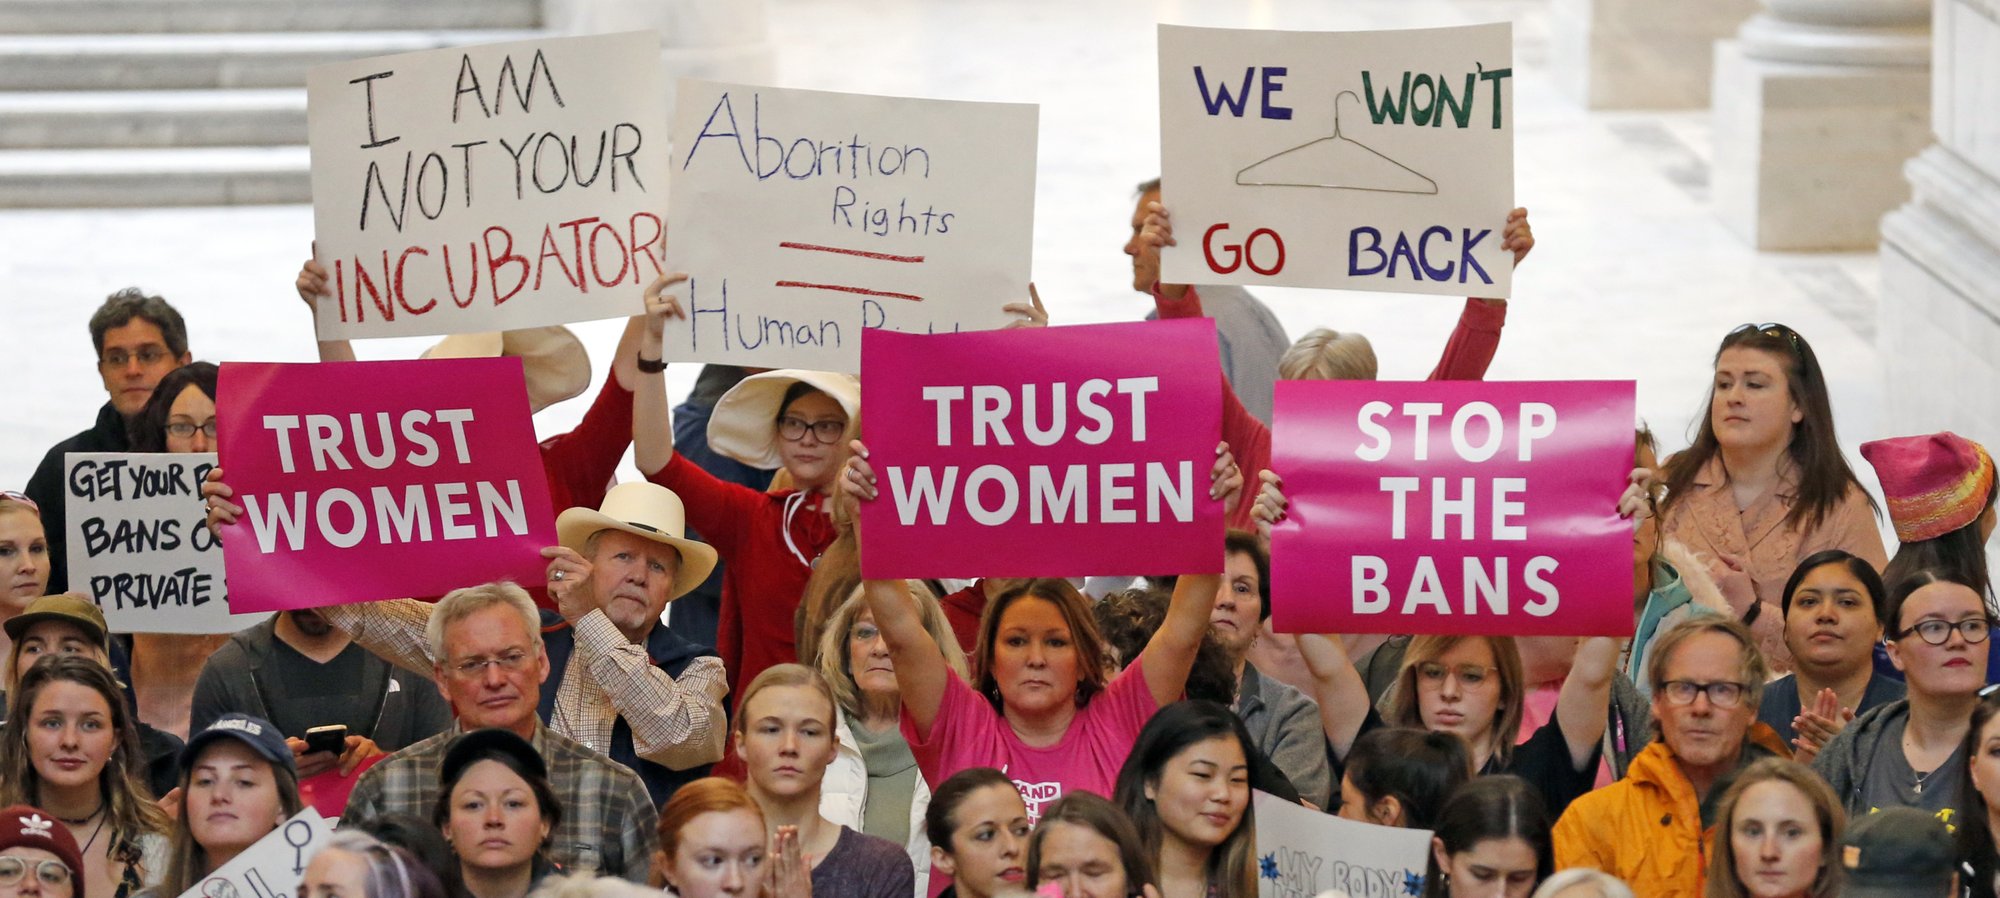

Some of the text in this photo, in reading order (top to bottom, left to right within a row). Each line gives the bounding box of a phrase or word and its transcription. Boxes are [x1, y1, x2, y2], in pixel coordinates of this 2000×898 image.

[350, 49, 564, 148] I AM
[1194, 61, 1512, 129] WE WON'T
[684, 92, 928, 180] Aborition
[360, 123, 646, 233] NOT YOUR
[832, 186, 954, 236] Rights
[335, 212, 664, 323] INCUBATOR
[1203, 223, 1494, 284] GO BACK
[691, 278, 840, 352] Human
[263, 409, 475, 474] TRUST
[922, 376, 1159, 446] TRUST
[1354, 400, 1557, 463] STOP
[69, 460, 128, 502] GET
[128, 463, 191, 499] YOUR
[886, 460, 1194, 527] WOMEN
[1379, 476, 1528, 540] THE
[80, 517, 181, 557] BANS
[241, 479, 529, 554] WOMEN
[90, 567, 212, 610] PRIVATE
[1351, 555, 1560, 617] BANS
[1280, 845, 1323, 896] MY
[1333, 860, 1400, 898] BODY
